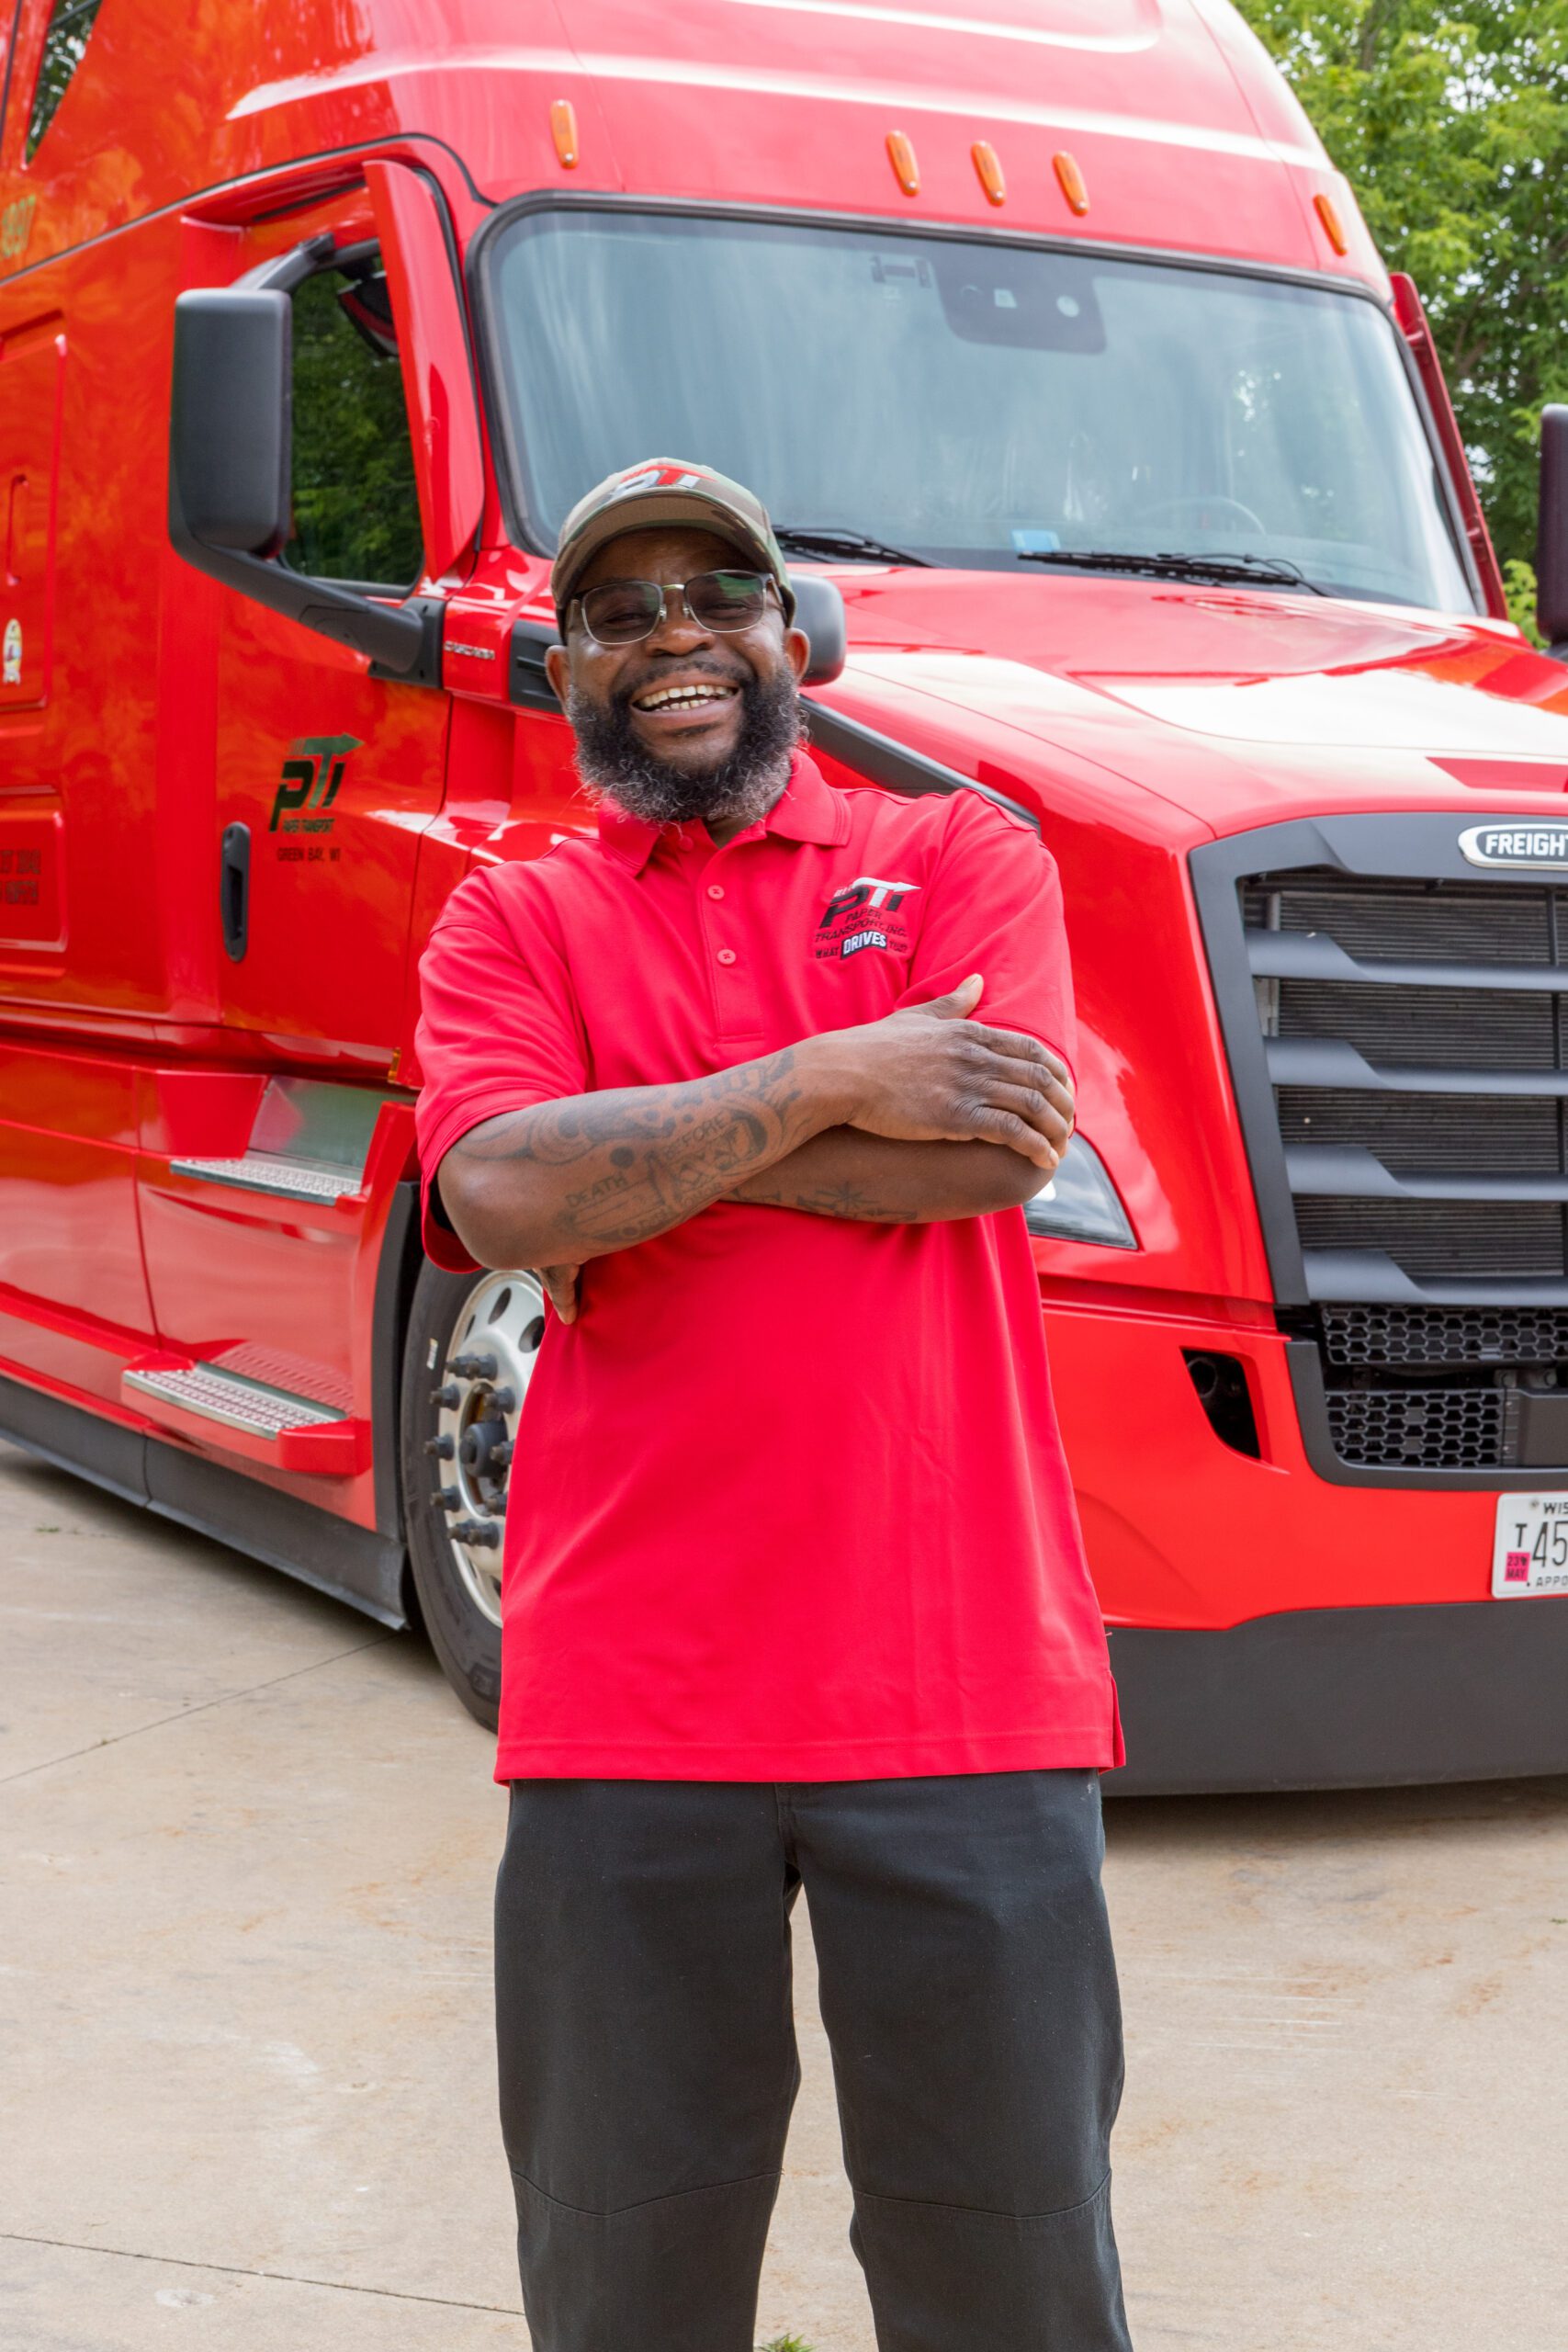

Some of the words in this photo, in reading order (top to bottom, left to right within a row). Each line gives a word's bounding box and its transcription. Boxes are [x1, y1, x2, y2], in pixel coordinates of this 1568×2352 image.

[269, 732, 365, 832] PTI
[819, 876, 922, 929] PTI
[845, 908, 883, 924] PAPER
[815, 945, 840, 959] WHAT
[841, 930, 888, 957] DRIVES
[565, 1170, 628, 1207] DEATH
[1506, 1567, 1526, 1578] MAY
